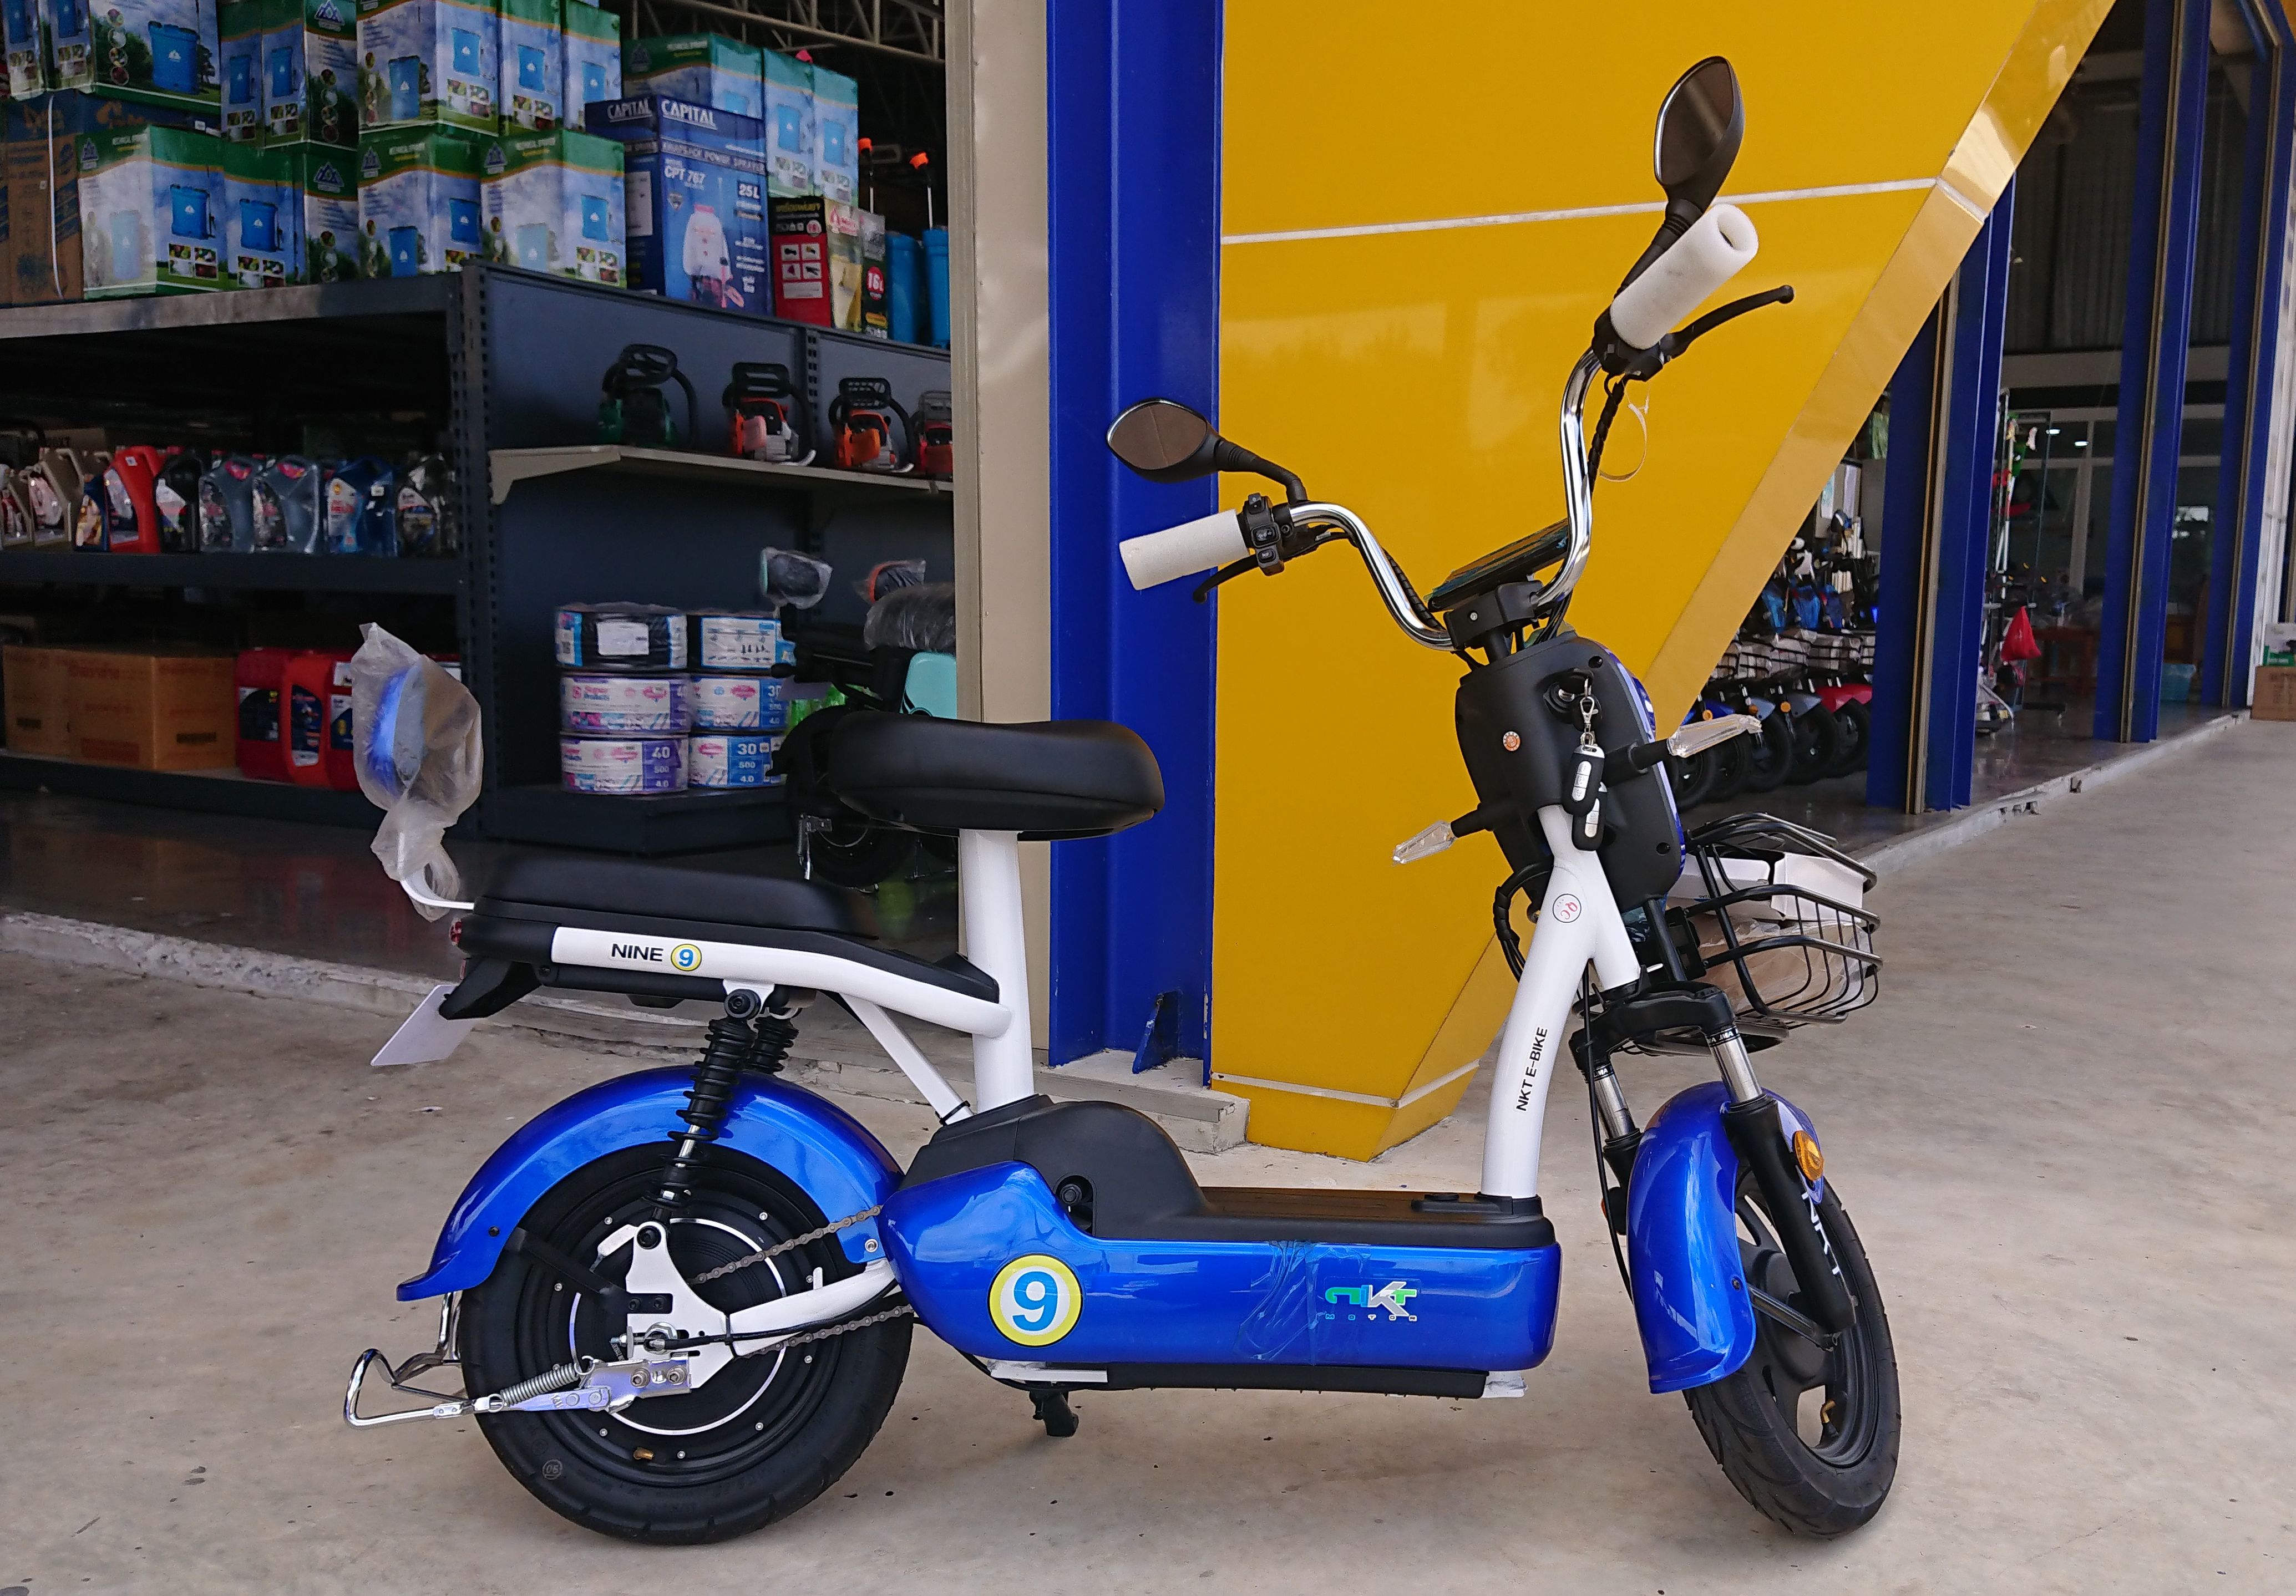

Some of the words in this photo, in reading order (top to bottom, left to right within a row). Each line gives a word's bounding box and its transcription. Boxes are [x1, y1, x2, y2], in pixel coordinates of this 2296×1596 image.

[661, 99, 715, 126] CAPITAL
[665, 166, 686, 181] CPT
[652, 746, 670, 759] 40
[737, 743, 757, 755] 30
[611, 943, 664, 962] NINE
[678, 949, 693, 967] 9
[1516, 1079, 1533, 1111] NKT
[1525, 1026, 1548, 1077] E-BIKE
[1012, 1270, 1058, 1331] 9
